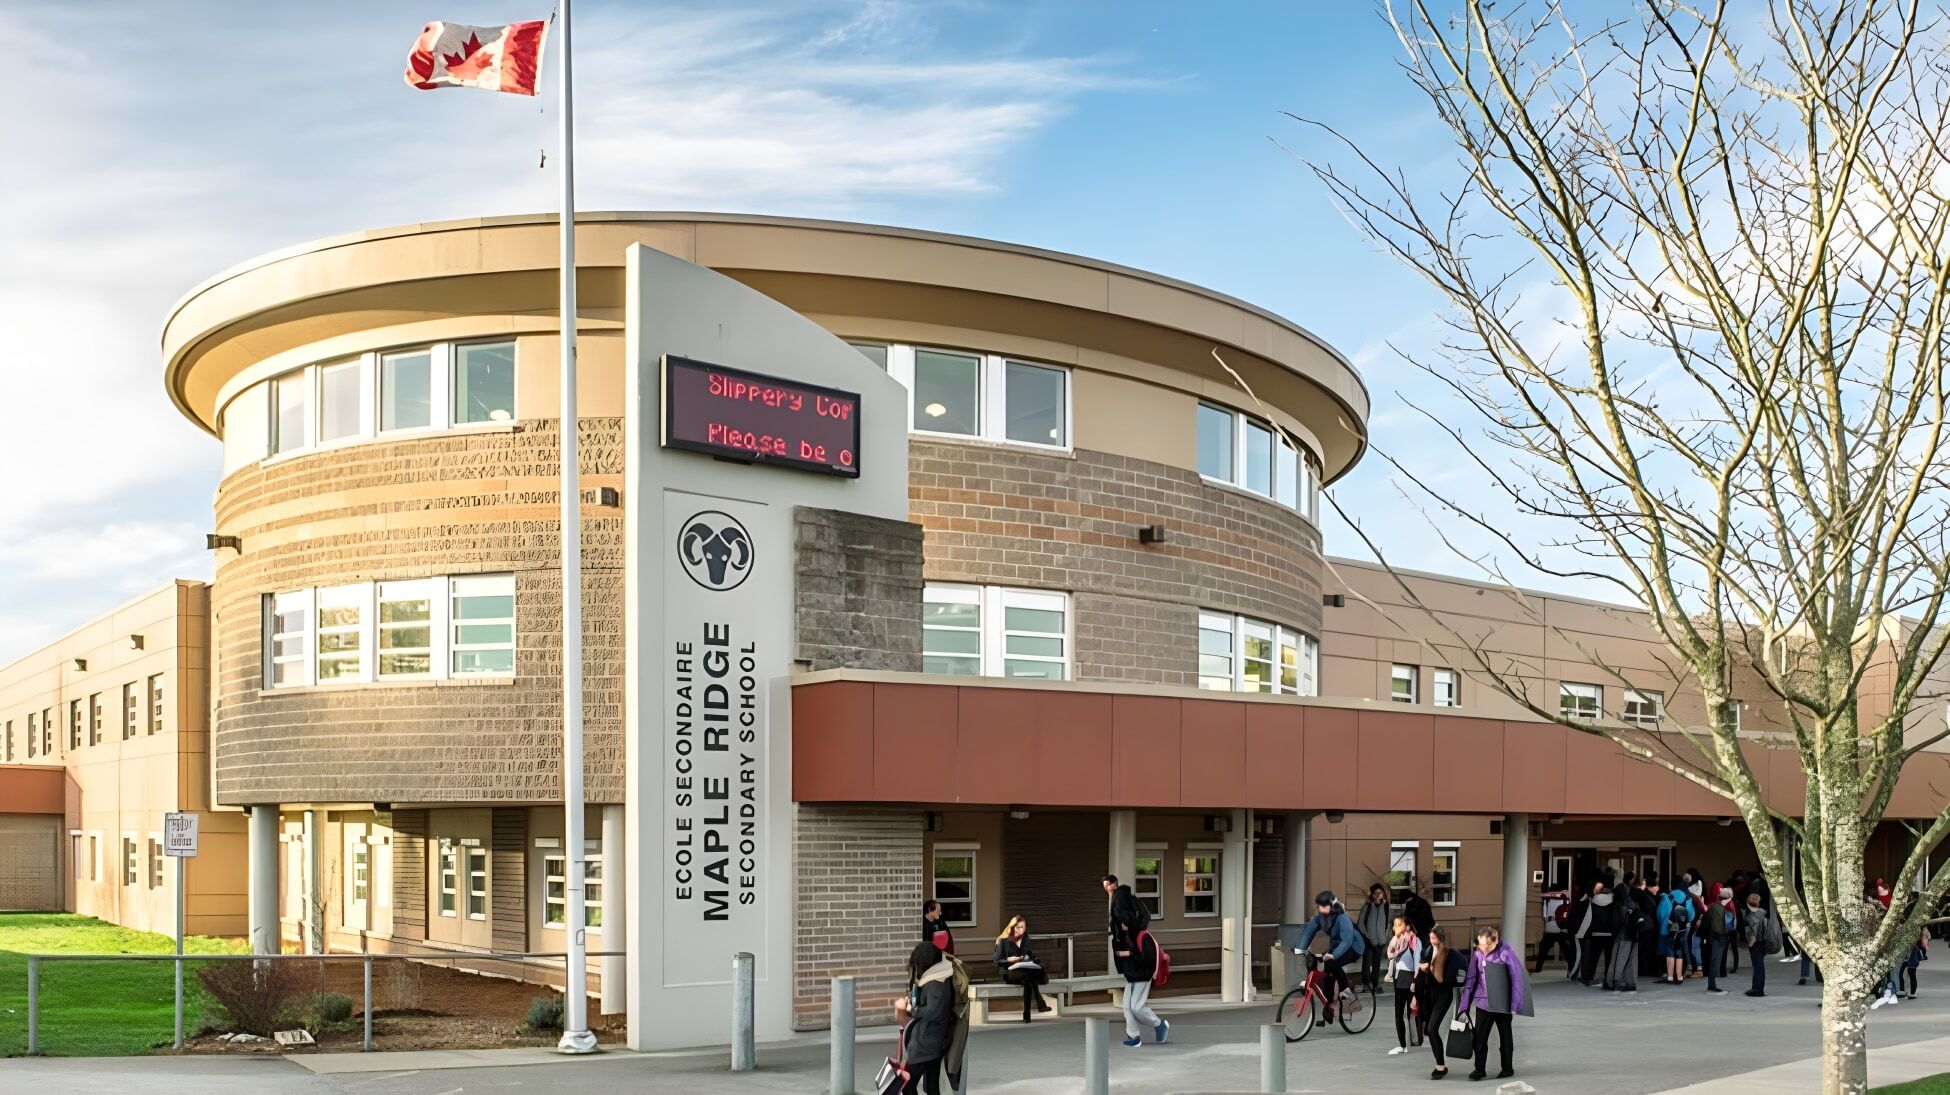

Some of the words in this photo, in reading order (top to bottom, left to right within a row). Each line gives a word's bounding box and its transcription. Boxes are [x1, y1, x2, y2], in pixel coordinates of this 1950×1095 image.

[708, 423, 787, 456] Please
[800, 440, 826, 462] be
[709, 374, 802, 411] Slippery
[675, 641, 693, 807] SECONDAIRE
[702, 622, 730, 752] RIDGE
[738, 641, 756, 743] SCHOOL
[675, 818, 693, 900] ECOLE
[703, 777, 729, 921] MAPLE
[738, 752, 756, 905] SECONDARY
